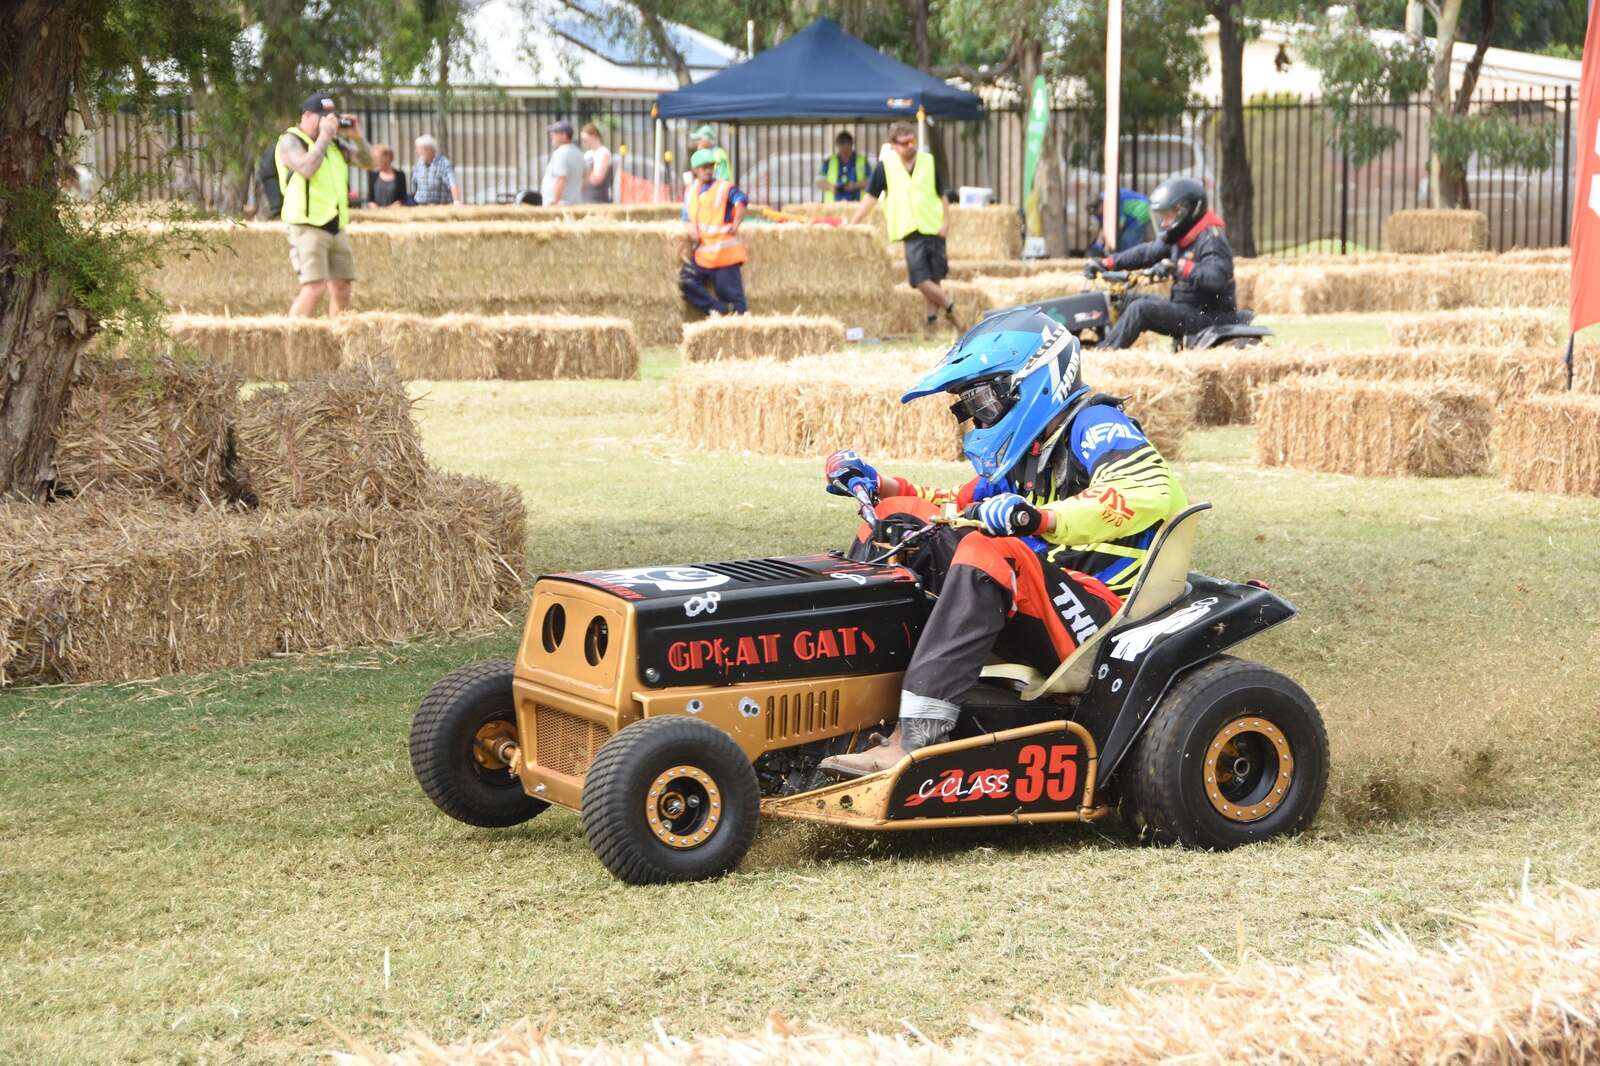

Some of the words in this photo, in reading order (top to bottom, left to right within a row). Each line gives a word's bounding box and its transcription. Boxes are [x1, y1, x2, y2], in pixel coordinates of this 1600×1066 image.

[918, 778, 935, 799] C
[940, 774, 1010, 797] CLASS
[1014, 744, 1078, 803] 35
